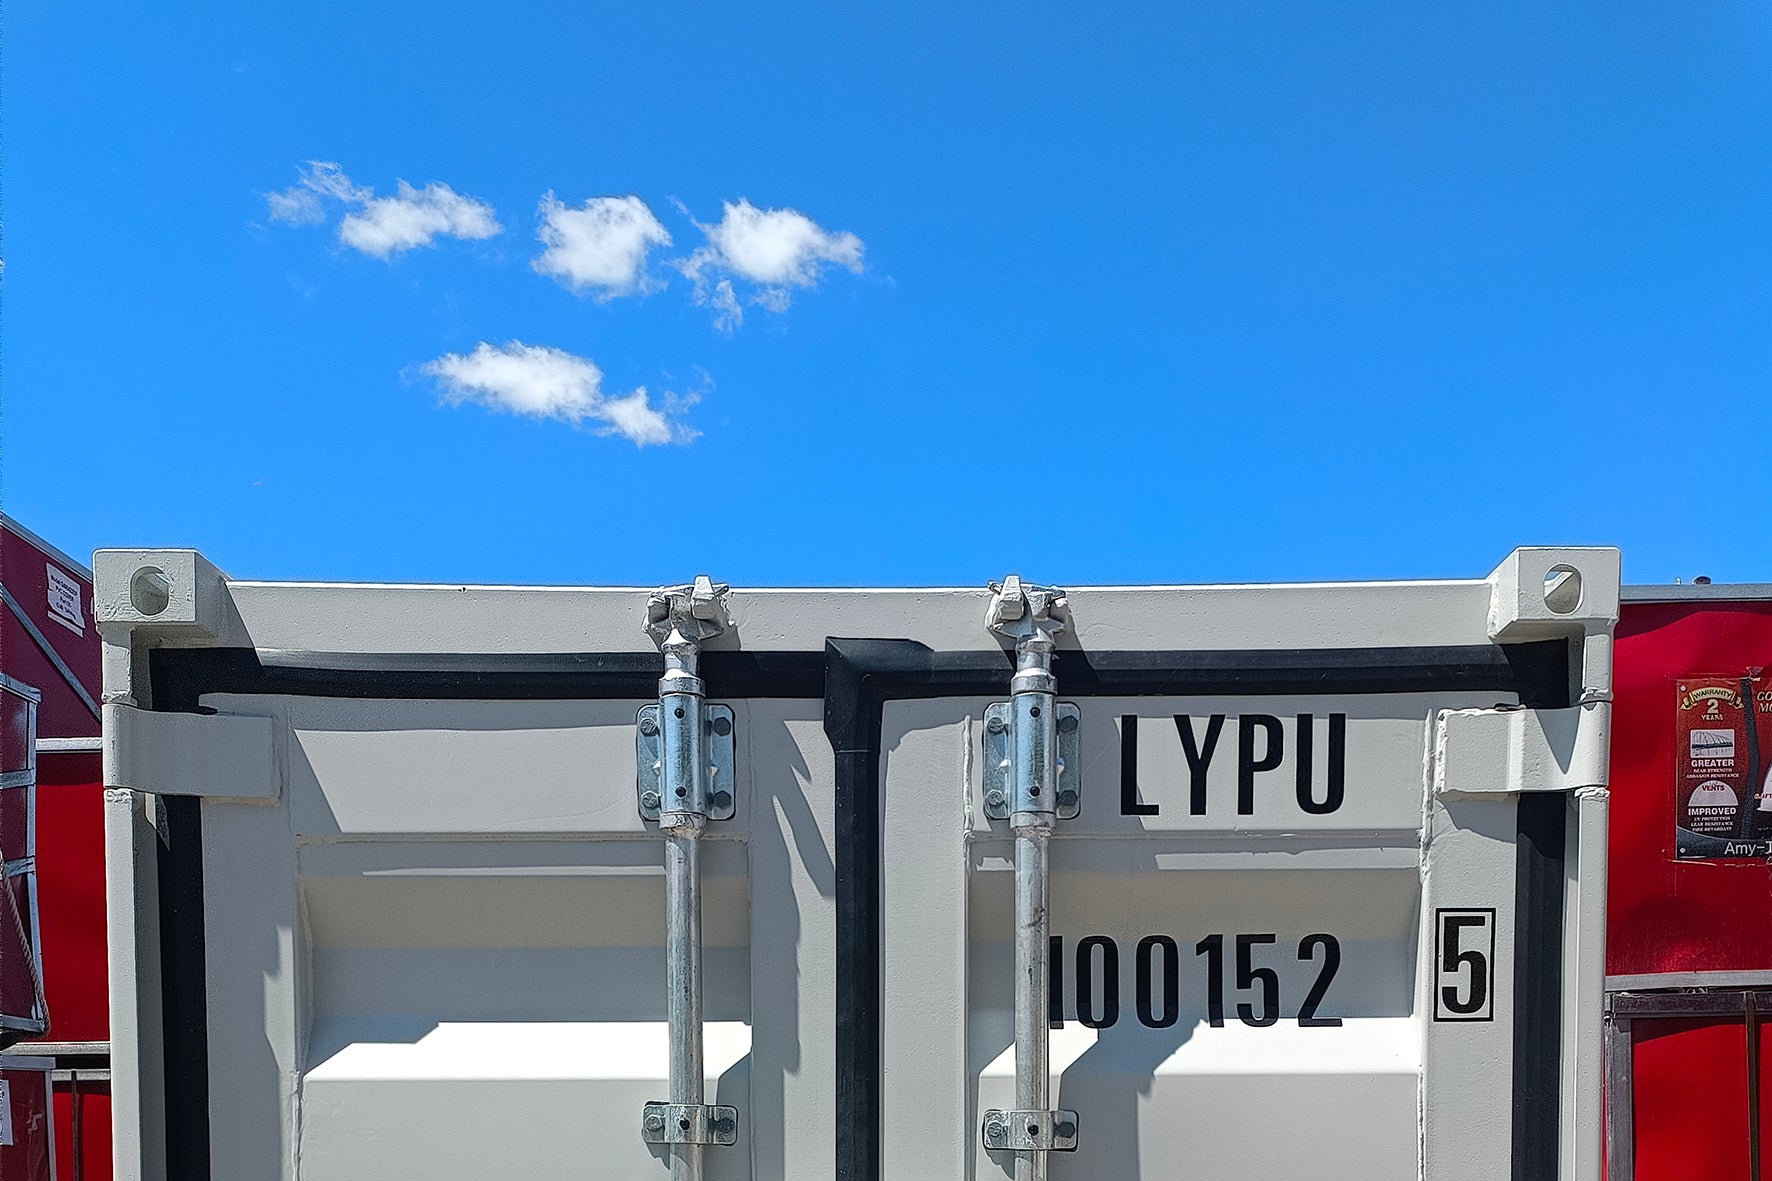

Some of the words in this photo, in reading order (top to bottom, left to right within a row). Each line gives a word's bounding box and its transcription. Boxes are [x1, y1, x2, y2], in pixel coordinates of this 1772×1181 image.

[1694, 689, 1732, 698] WARRANTY
[1707, 698, 1719, 714] 2
[1120, 713, 1346, 816] LYPU
[1691, 759, 1735, 767] GREATER
[1688, 807, 1737, 816] IMPROVED
[1441, 916, 1488, 1014] 5
[1049, 933, 1343, 1030] 100152
